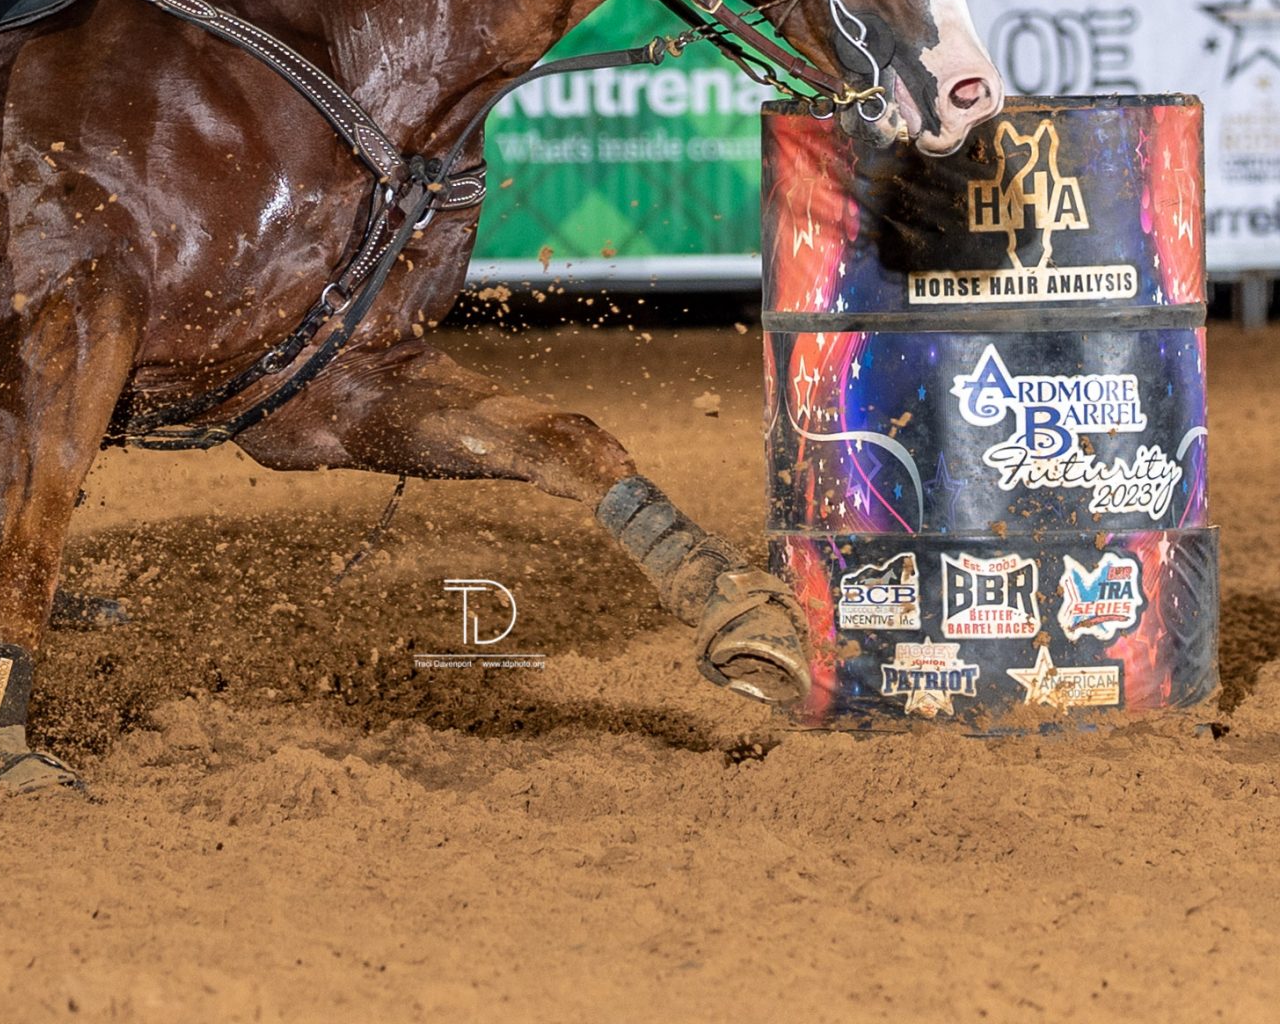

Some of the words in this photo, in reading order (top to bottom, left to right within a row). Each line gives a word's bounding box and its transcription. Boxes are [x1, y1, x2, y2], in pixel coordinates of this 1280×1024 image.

[915, 278, 981, 297] HORSE
[990, 276, 1039, 295] HAIR
[1047, 273, 1133, 293] ANALYSIS
[962, 355, 1136, 419] ARDMORE
[1016, 402, 1144, 460] BARREL
[989, 445, 1182, 514] Futurity
[1094, 483, 1154, 509] 2023
[963, 558, 985, 574] Est.
[843, 586, 916, 605] BCB
[946, 561, 1037, 621] BBR
[969, 609, 1014, 621] BETTER
[1072, 602, 1132, 616] SERIES
[842, 614, 895, 626] INCENTIVE
[948, 622, 992, 635] BARREL
[997, 622, 1036, 635] RACES
[883, 667, 977, 694] PATRIOT
[1039, 674, 1117, 691] AMERICAN
